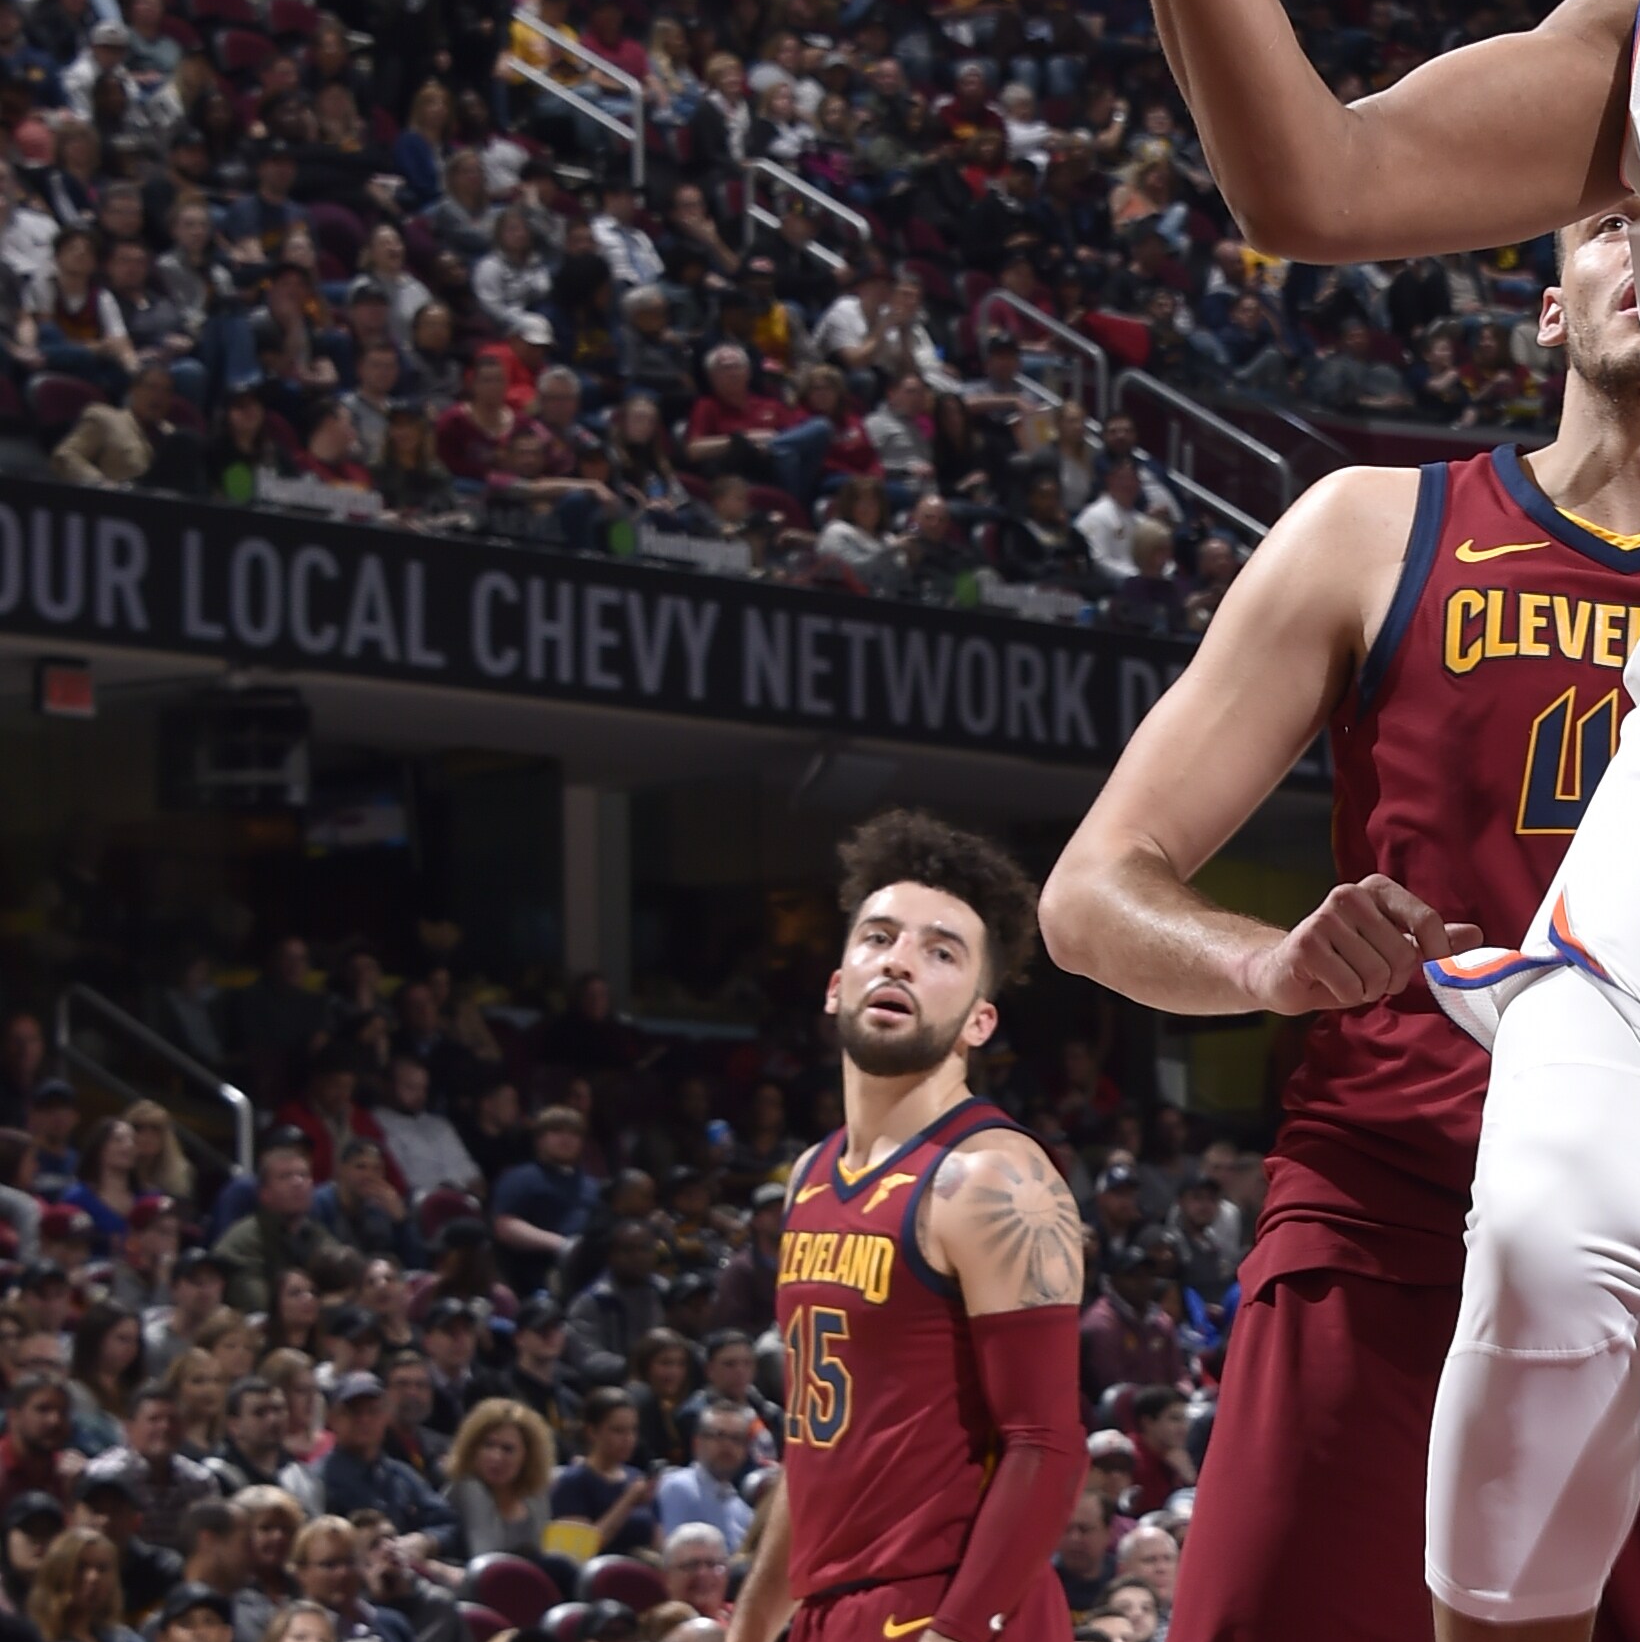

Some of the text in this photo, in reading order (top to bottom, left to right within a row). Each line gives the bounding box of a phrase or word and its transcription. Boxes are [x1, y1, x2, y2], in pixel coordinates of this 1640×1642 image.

[182, 529, 448, 670] LOCAL
[471, 569, 722, 701] CHEVY
[741, 604, 1099, 750] NETWORK
[786, 1304, 853, 1448] 15
